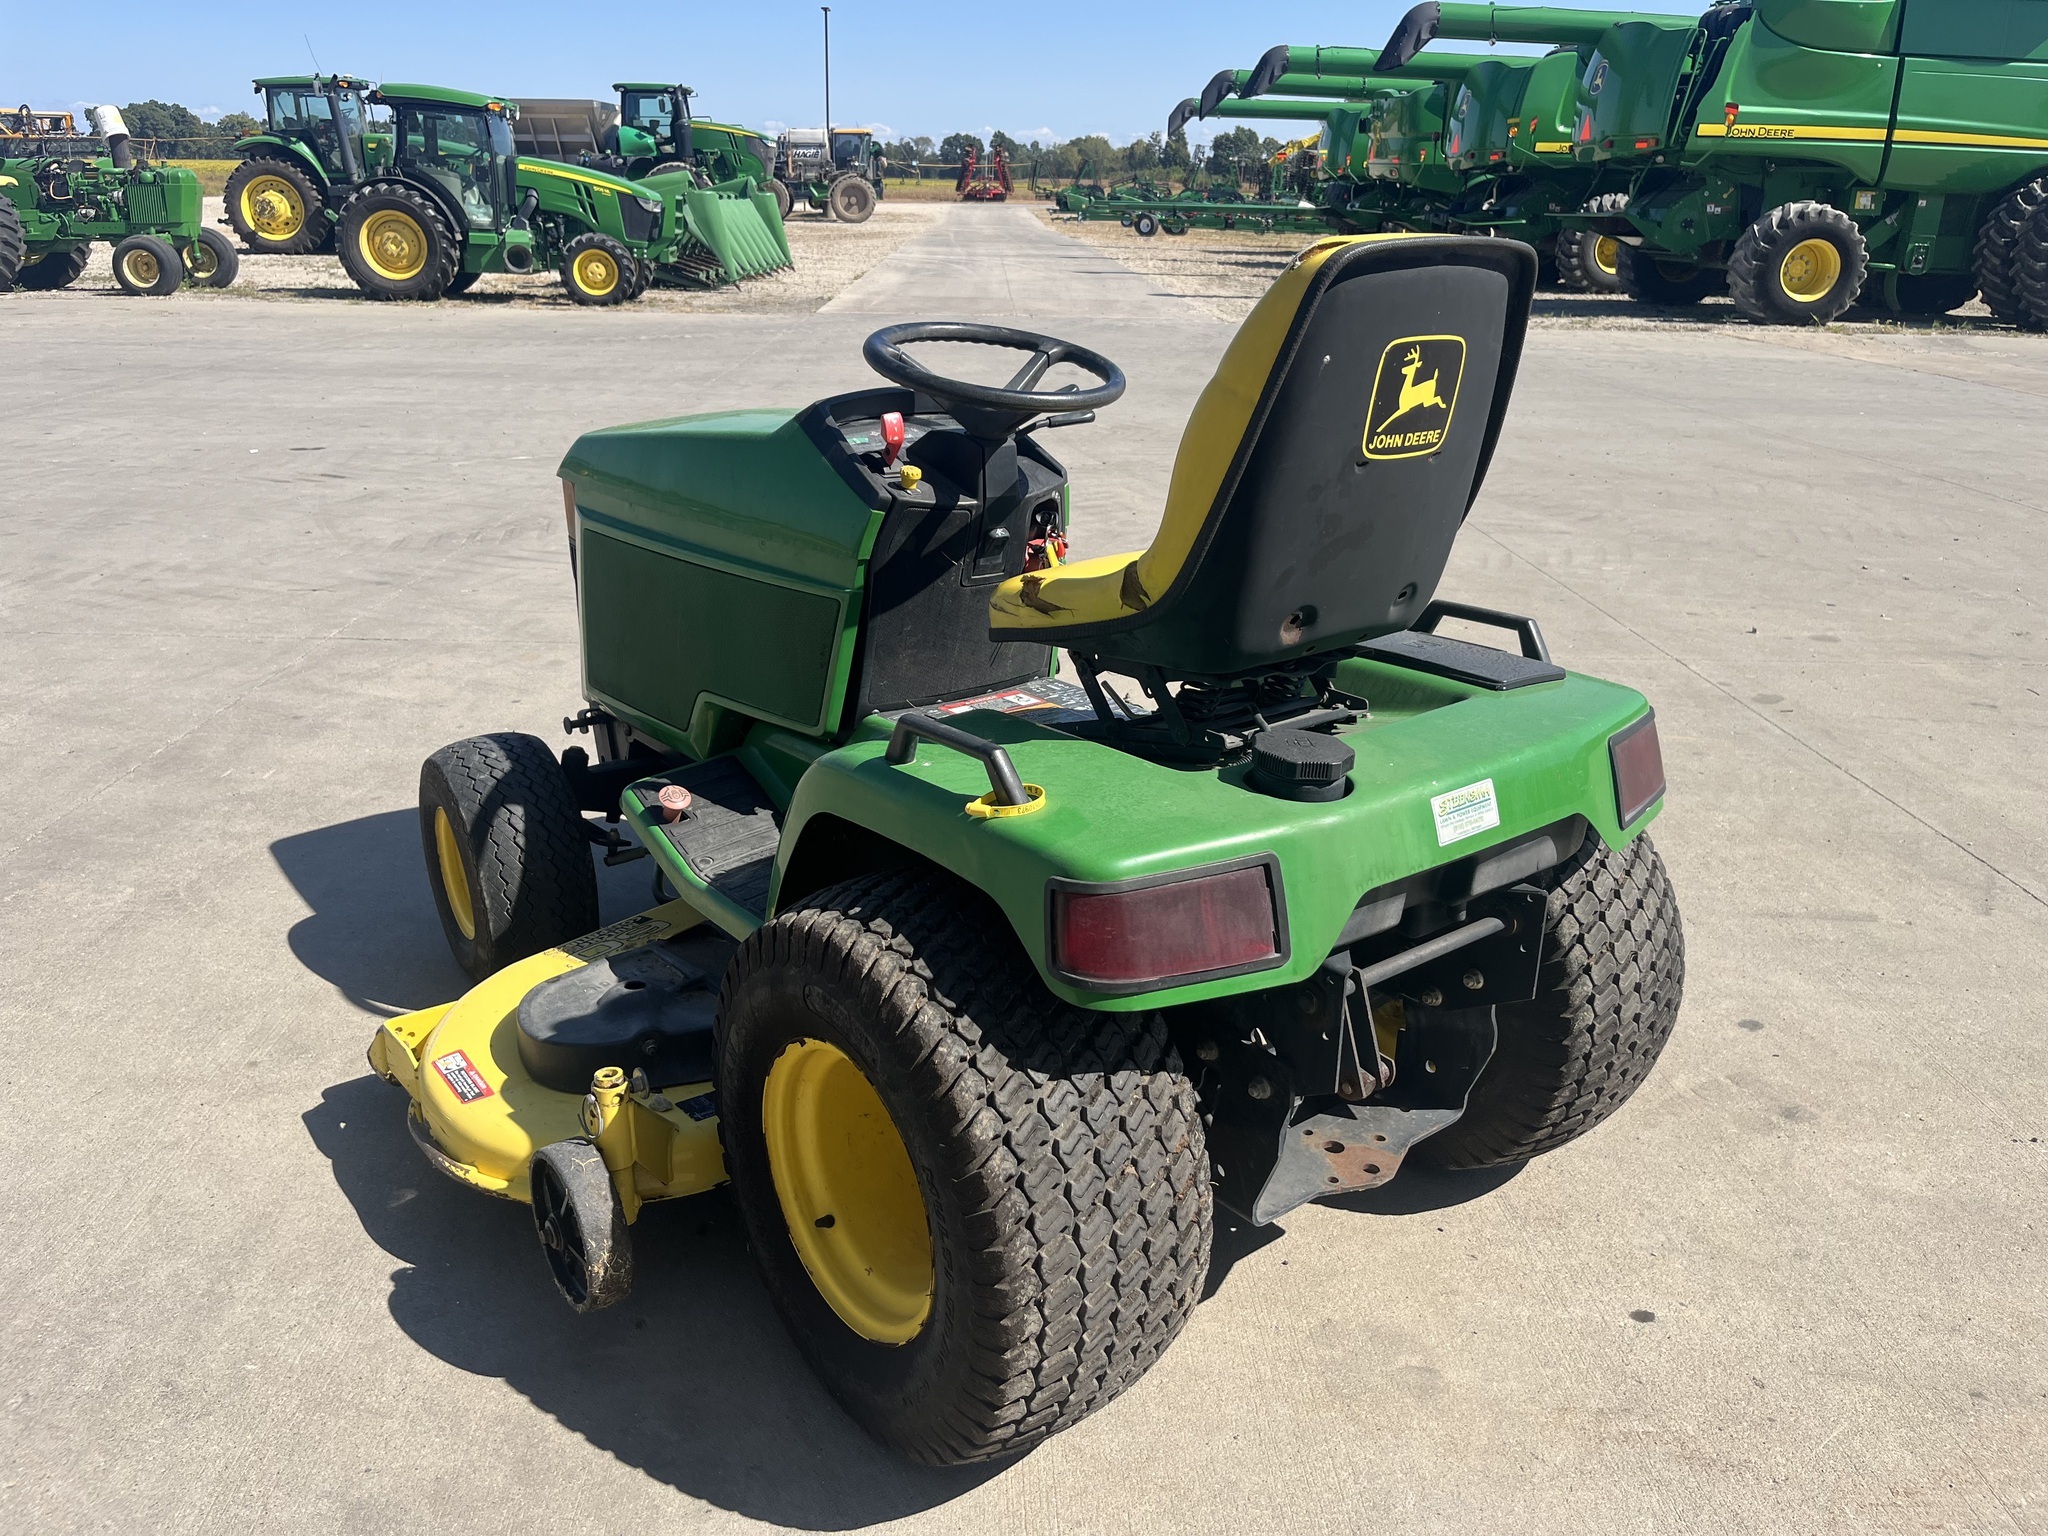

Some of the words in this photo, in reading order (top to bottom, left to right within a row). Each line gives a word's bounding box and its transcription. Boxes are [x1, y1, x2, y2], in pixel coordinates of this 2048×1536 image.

[1758, 127, 1795, 137] DEERE
[793, 150, 821, 159] HAGIE
[1369, 434, 1404, 449] JOHN
[1404, 429, 1441, 446] DEERE
